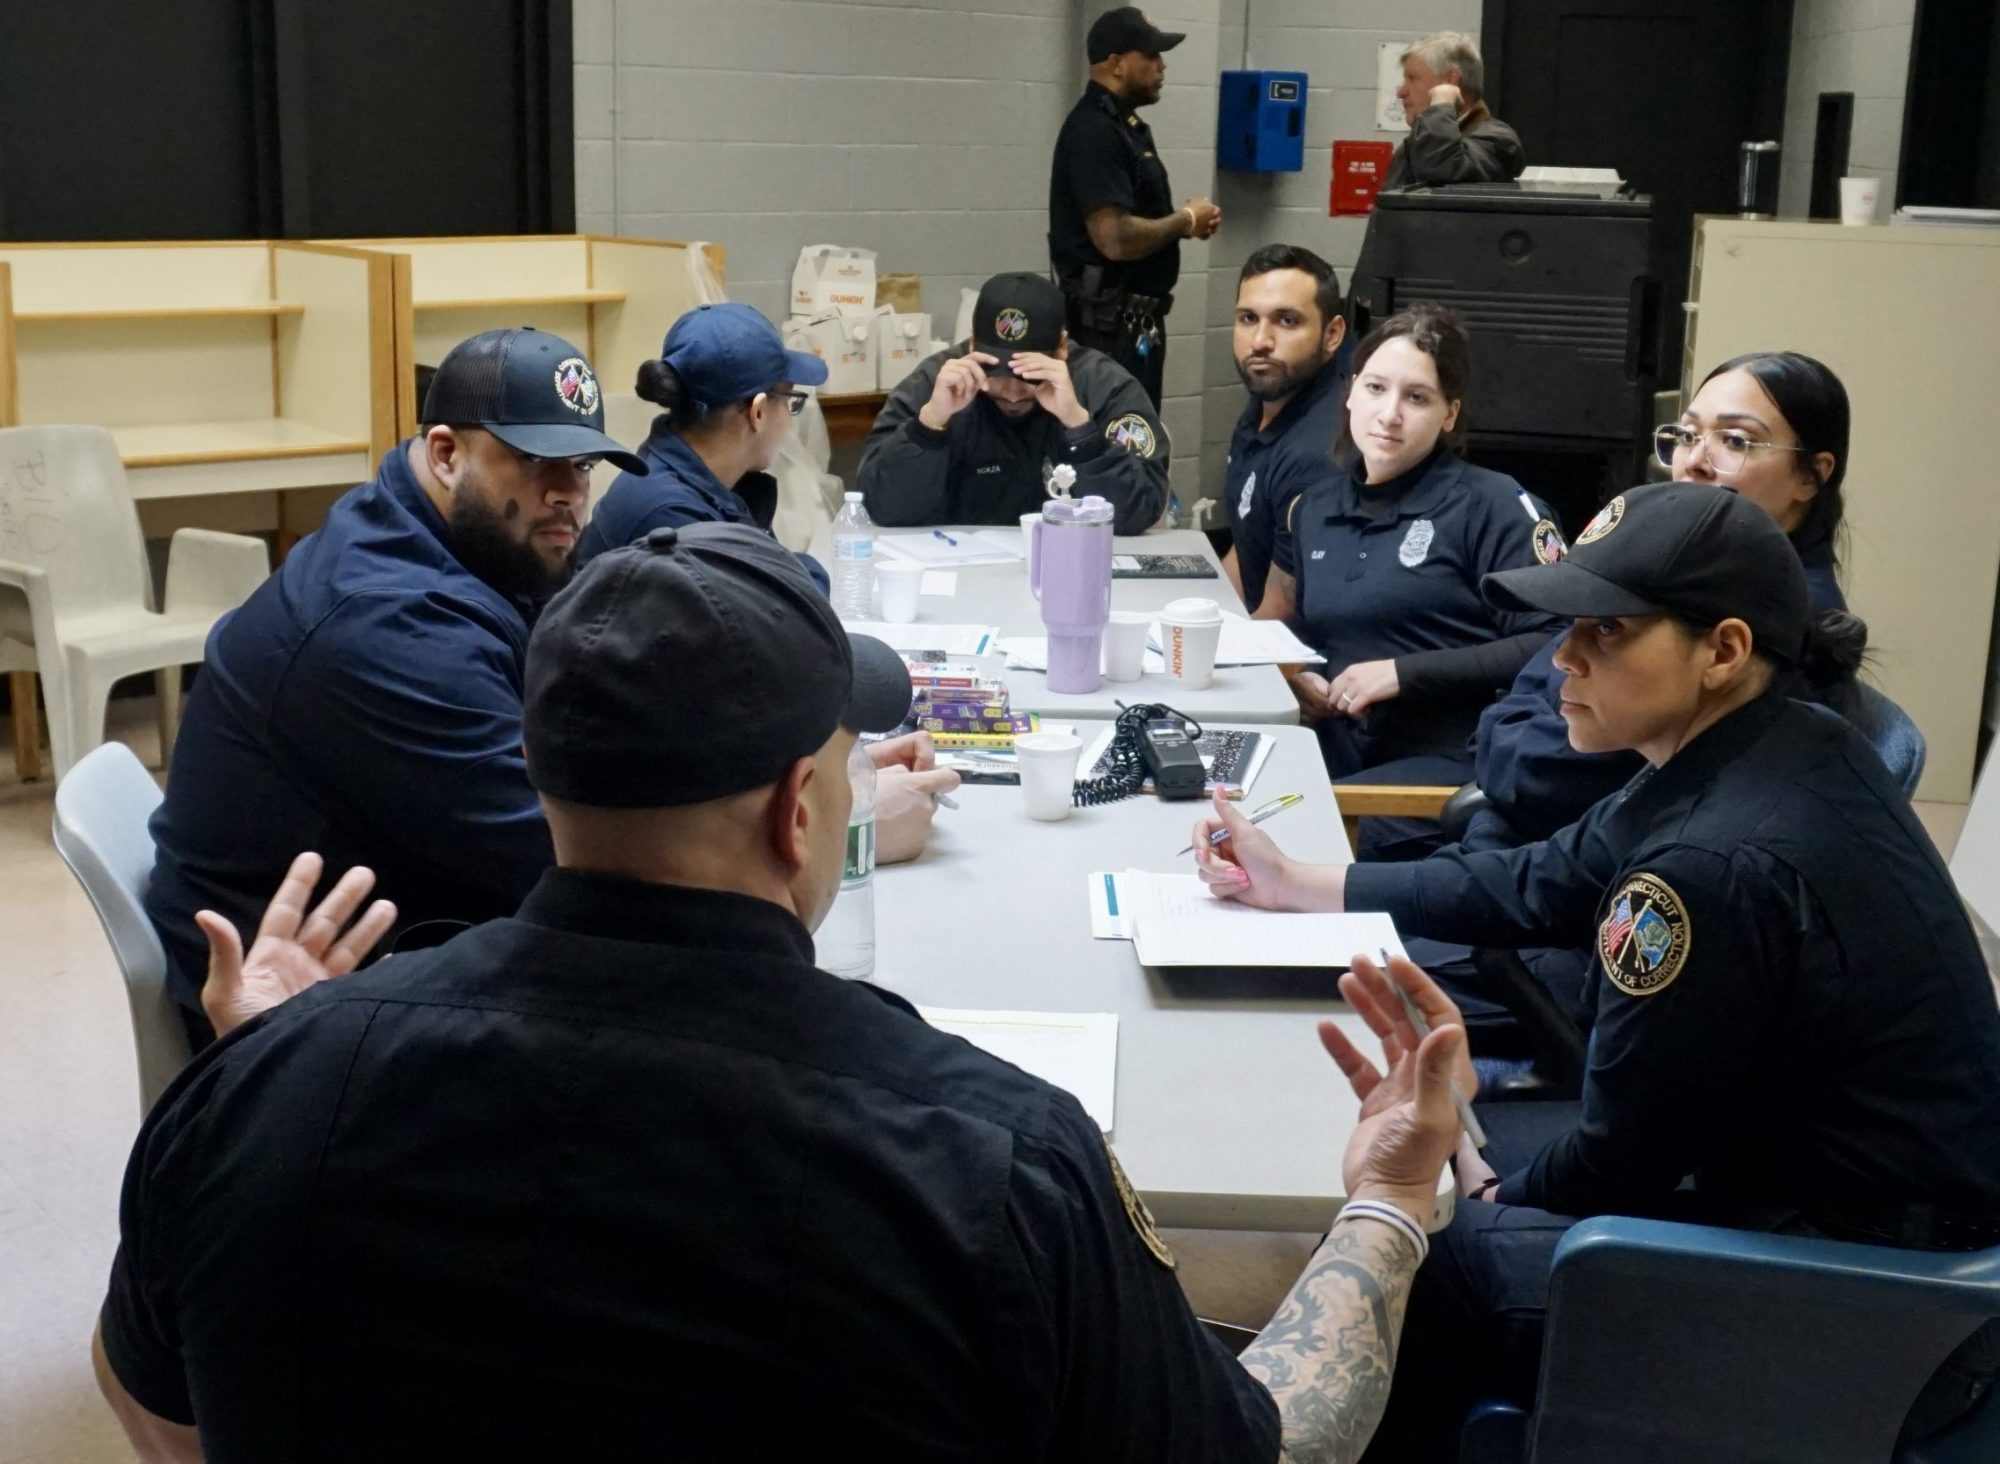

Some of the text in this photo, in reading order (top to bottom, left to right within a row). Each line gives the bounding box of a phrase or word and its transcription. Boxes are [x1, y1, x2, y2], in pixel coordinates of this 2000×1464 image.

[1173, 625, 1183, 678] DUNKIN'
[1624, 974, 1637, 987] OF
[1640, 922, 1684, 987] CORRECTION
